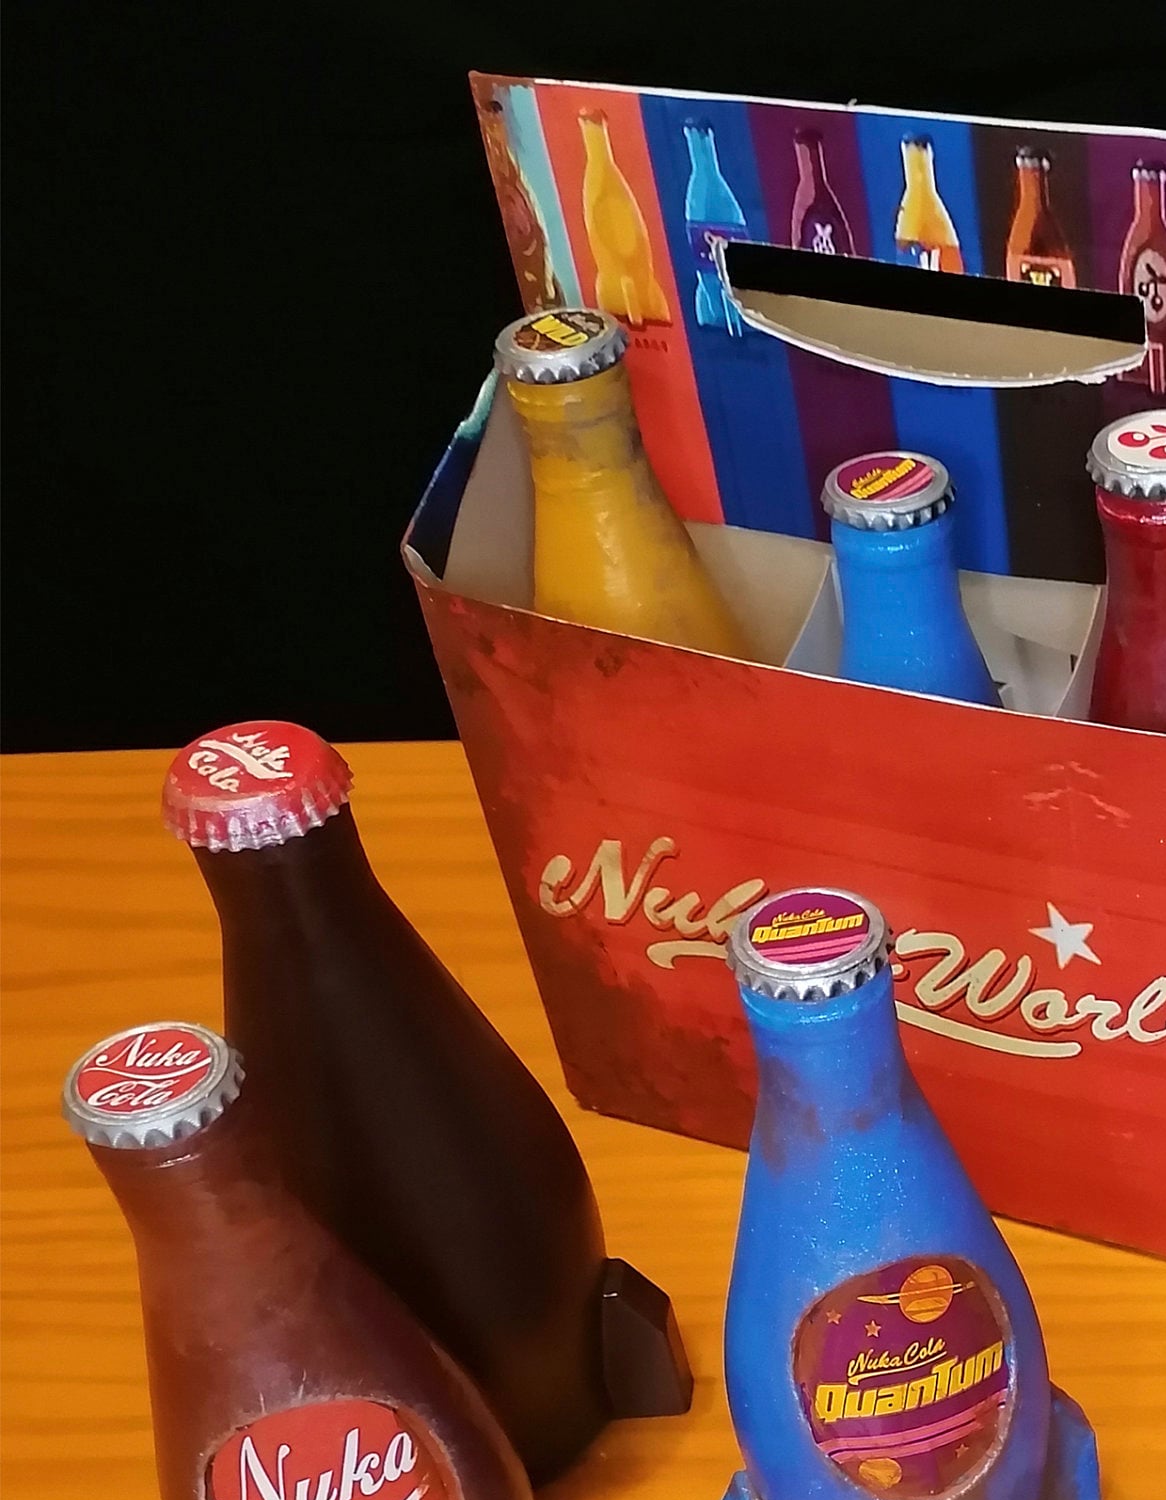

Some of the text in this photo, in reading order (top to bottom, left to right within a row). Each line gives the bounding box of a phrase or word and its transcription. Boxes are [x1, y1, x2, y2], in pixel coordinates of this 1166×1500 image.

[188, 750, 240, 793] Cola
[96, 1033, 201, 1068] Nuka
[87, 1079, 180, 1106] Cola
[848, 1337, 946, 1376] Nuka Cola
